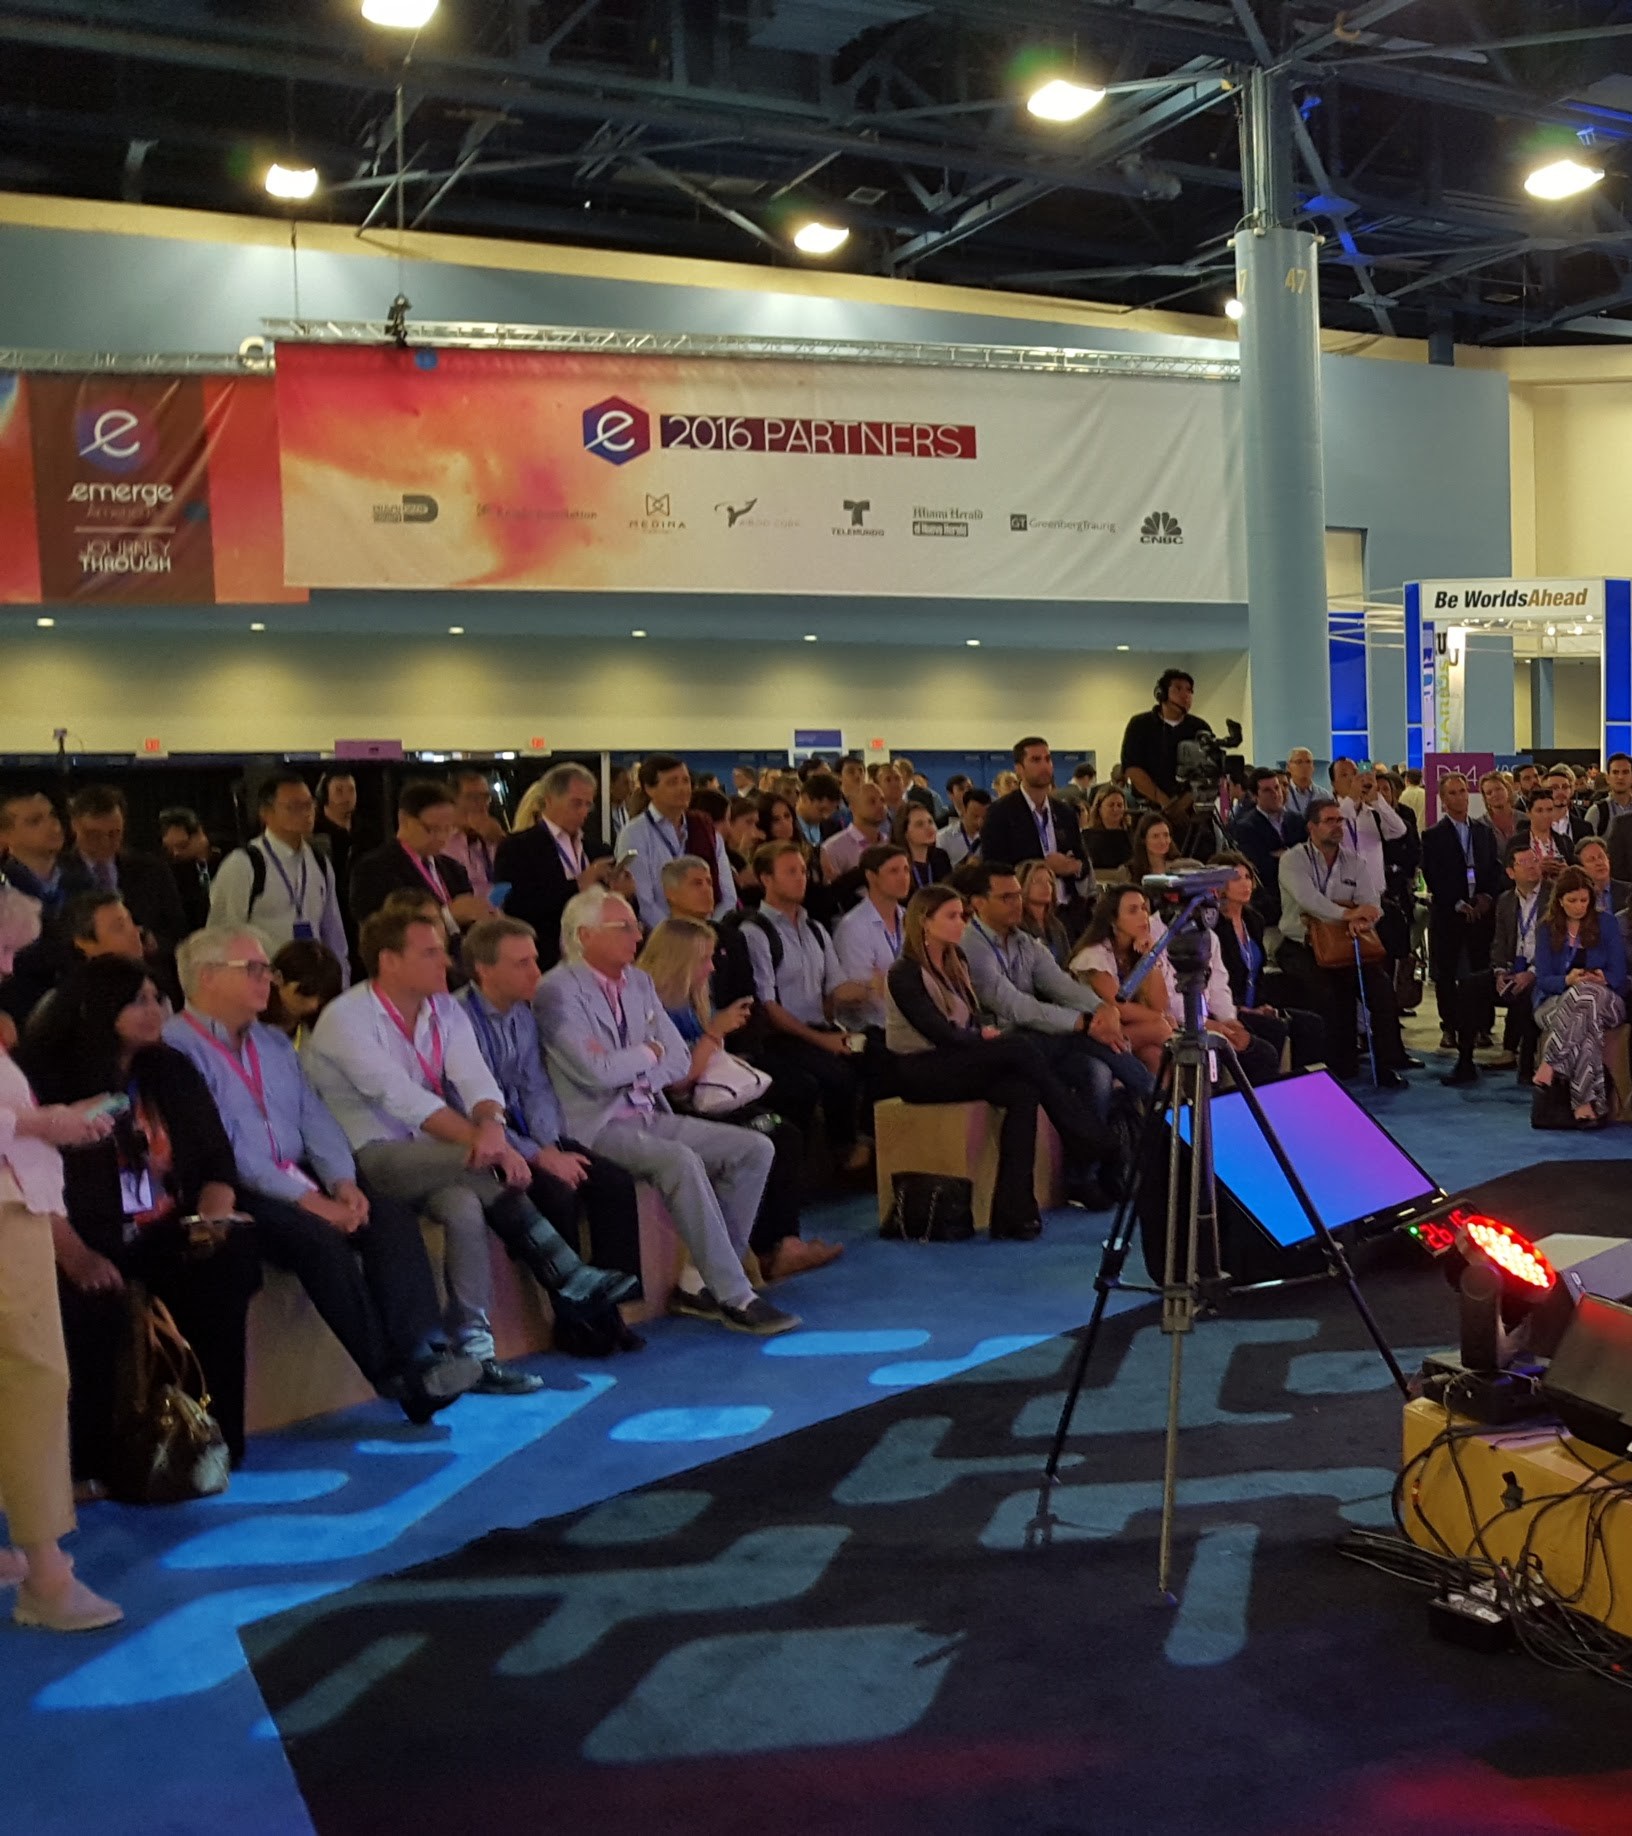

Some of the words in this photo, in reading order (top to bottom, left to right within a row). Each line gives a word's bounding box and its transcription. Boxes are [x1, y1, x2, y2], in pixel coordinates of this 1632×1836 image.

[1285, 267, 1307, 295] 47
[668, 415, 752, 451] 2016
[763, 418, 962, 458] PARTNERS
[67, 482, 174, 507] emerge
[1140, 536, 1184, 545] CNBC
[80, 555, 171, 573] THROUGH
[1434, 591, 1459, 609] Be
